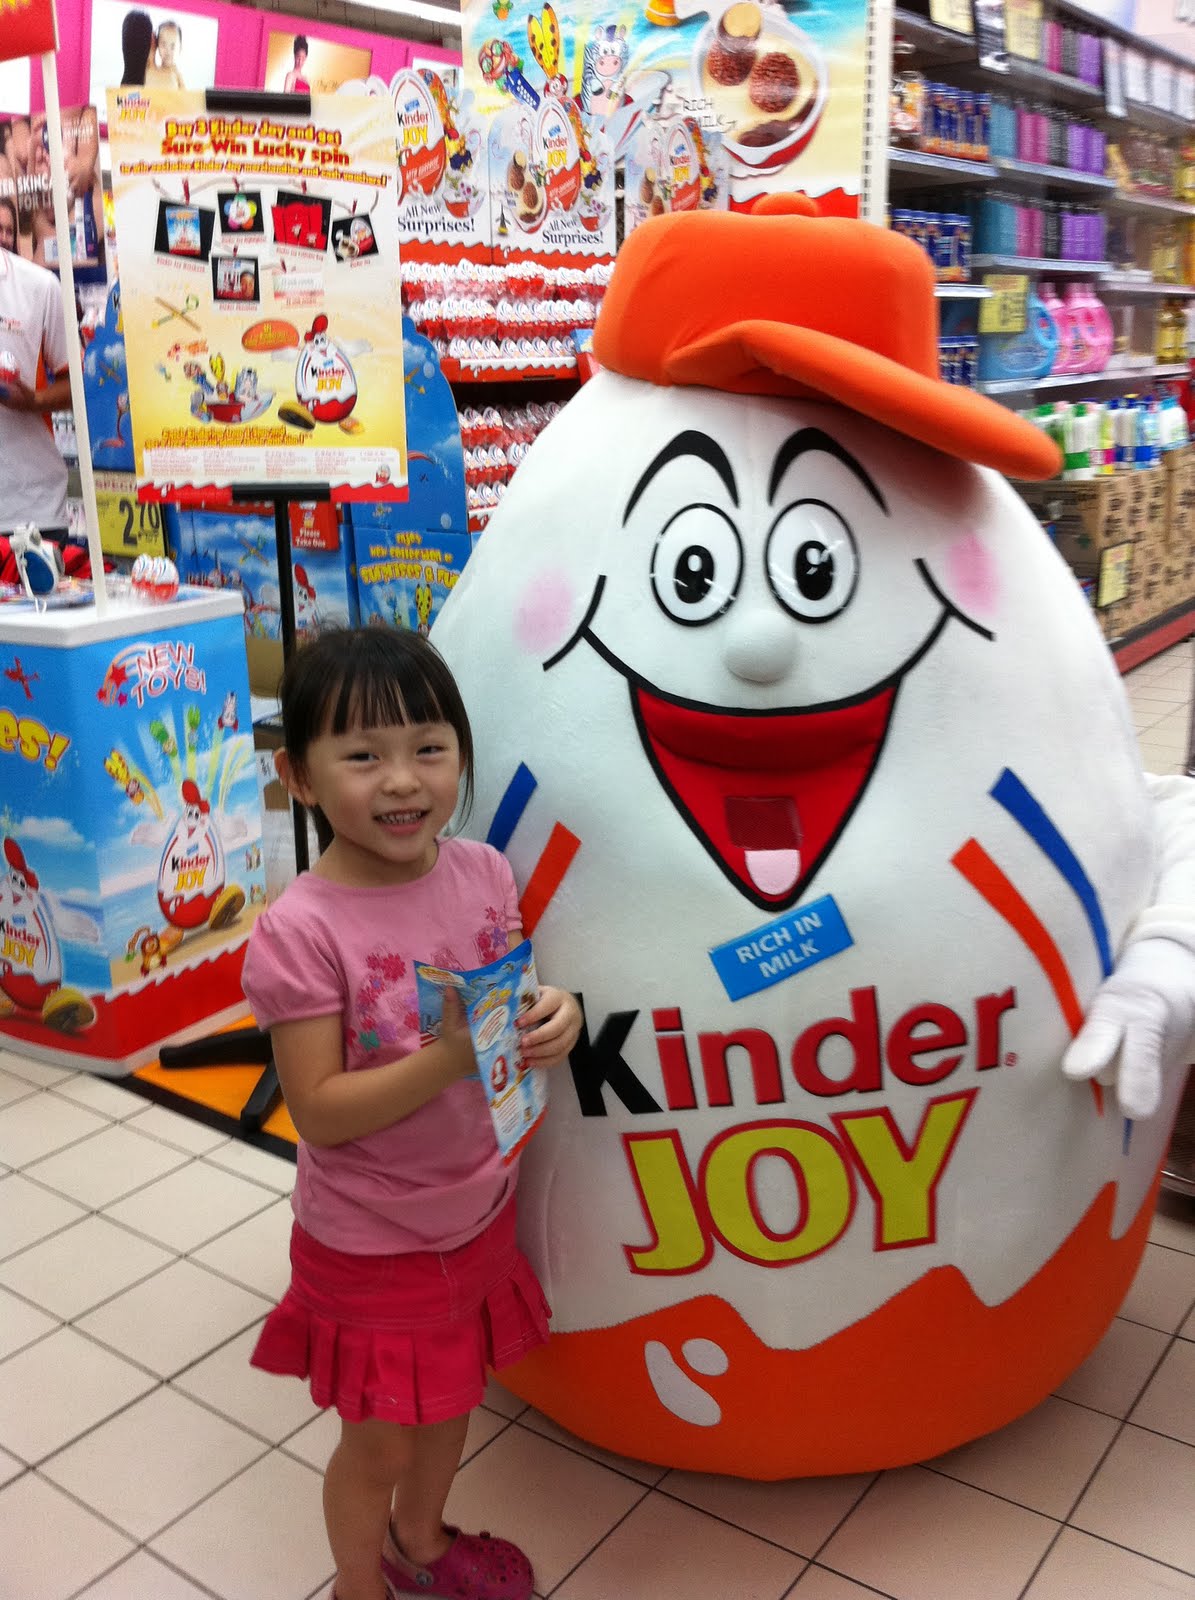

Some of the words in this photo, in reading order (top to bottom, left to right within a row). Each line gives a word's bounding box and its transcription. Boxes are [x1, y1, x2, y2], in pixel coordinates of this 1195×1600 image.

[165, 118, 194, 139] Buy
[208, 116, 257, 139] Kinder
[258, 118, 286, 142] Joy
[287, 121, 315, 142] and
[315, 125, 342, 147] get
[402, 125, 429, 147] JOY
[253, 138, 307, 163] Lucky
[310, 146, 350, 167] spin
[547, 150, 568, 169] JOY
[397, 214, 476, 236] Surprises!
[405, 203, 419, 220] All
[420, 202, 441, 217] New
[548, 219, 560, 232] All
[560, 217, 577, 230] New
[542, 229, 605, 247] Surprises!
[137, 640, 196, 680] NEW
[131, 663, 208, 709] TOYS!
[174, 866, 208, 892] JOY
[2, 932, 38, 969] JOY
[734, 928, 792, 965] RICH
[797, 911, 824, 938] IN
[757, 938, 821, 980] MILK
[620, 1085, 983, 1278] JOY
